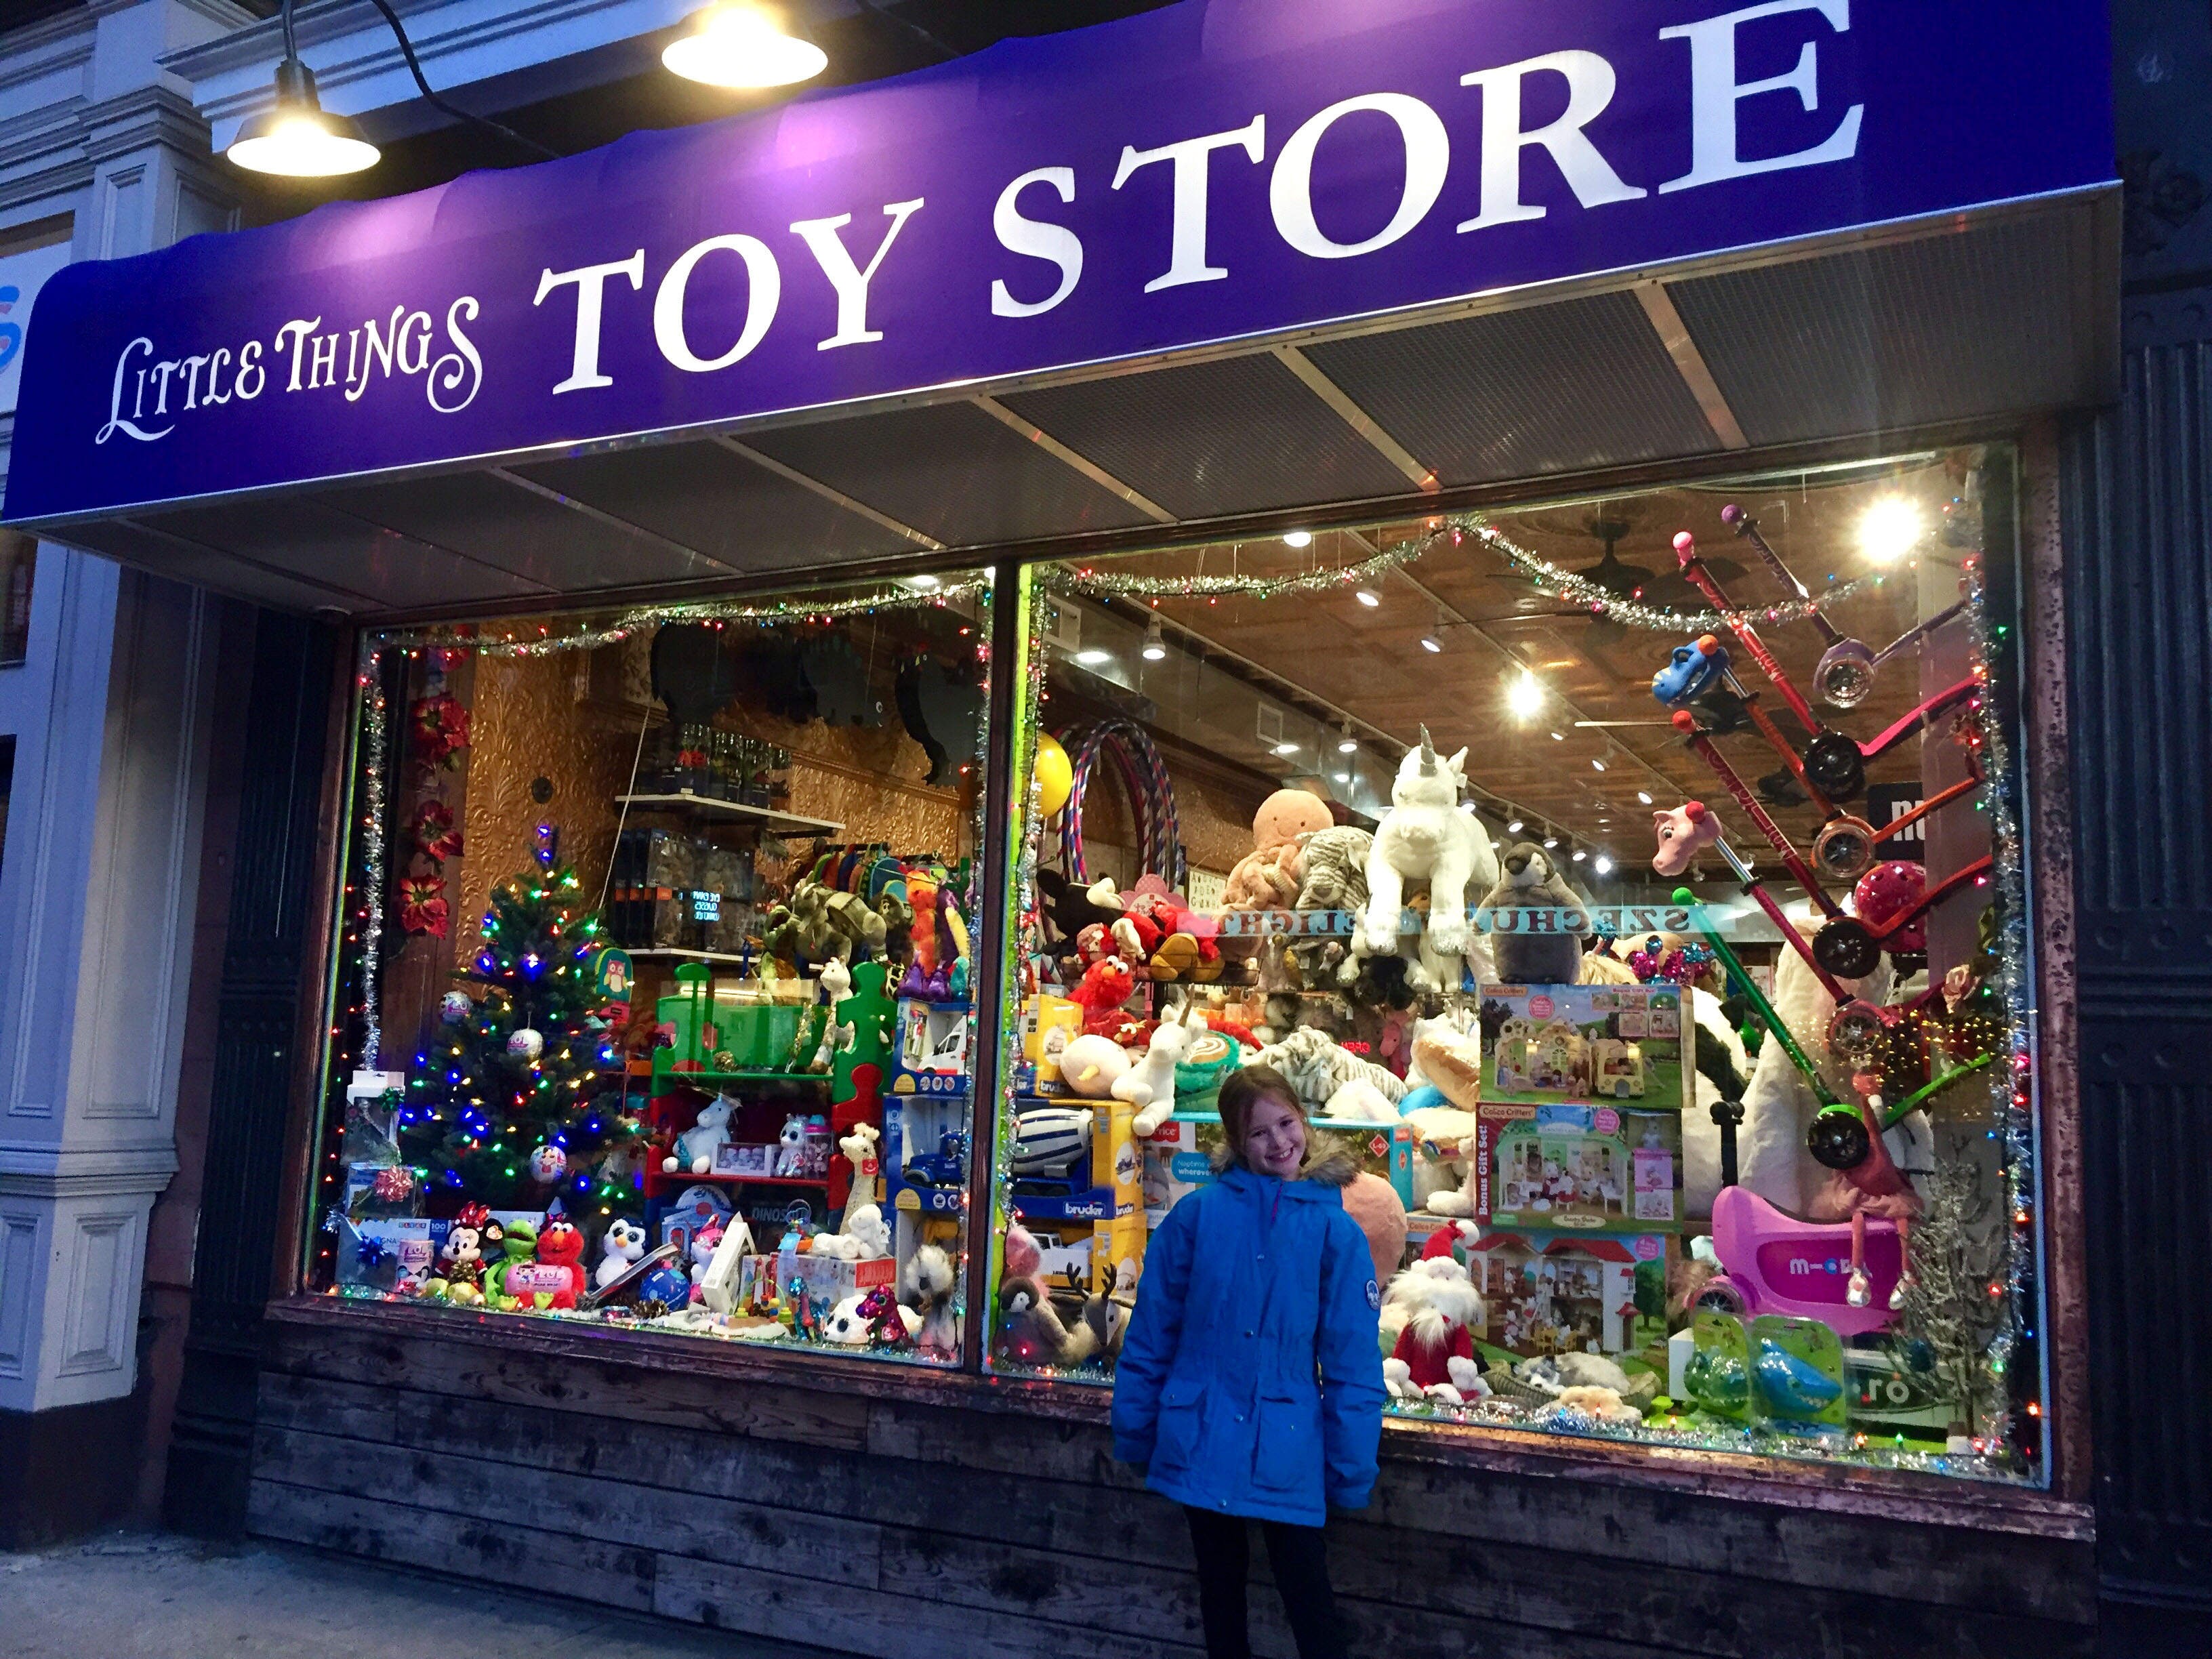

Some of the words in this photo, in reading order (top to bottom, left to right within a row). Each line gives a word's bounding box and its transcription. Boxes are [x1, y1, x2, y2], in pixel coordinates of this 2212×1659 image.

[533, 197, 924, 394] TOY
[991, 0, 1864, 318] STORE
[1483, 1107, 1505, 1117] Calico
[1507, 1107, 1533, 1117] Critters
[1478, 1125, 1488, 1149] Set!
[1478, 1150, 1488, 1175] Gift
[1478, 1177, 1488, 1215] Bonus
[1065, 1202, 1103, 1216] bruder
